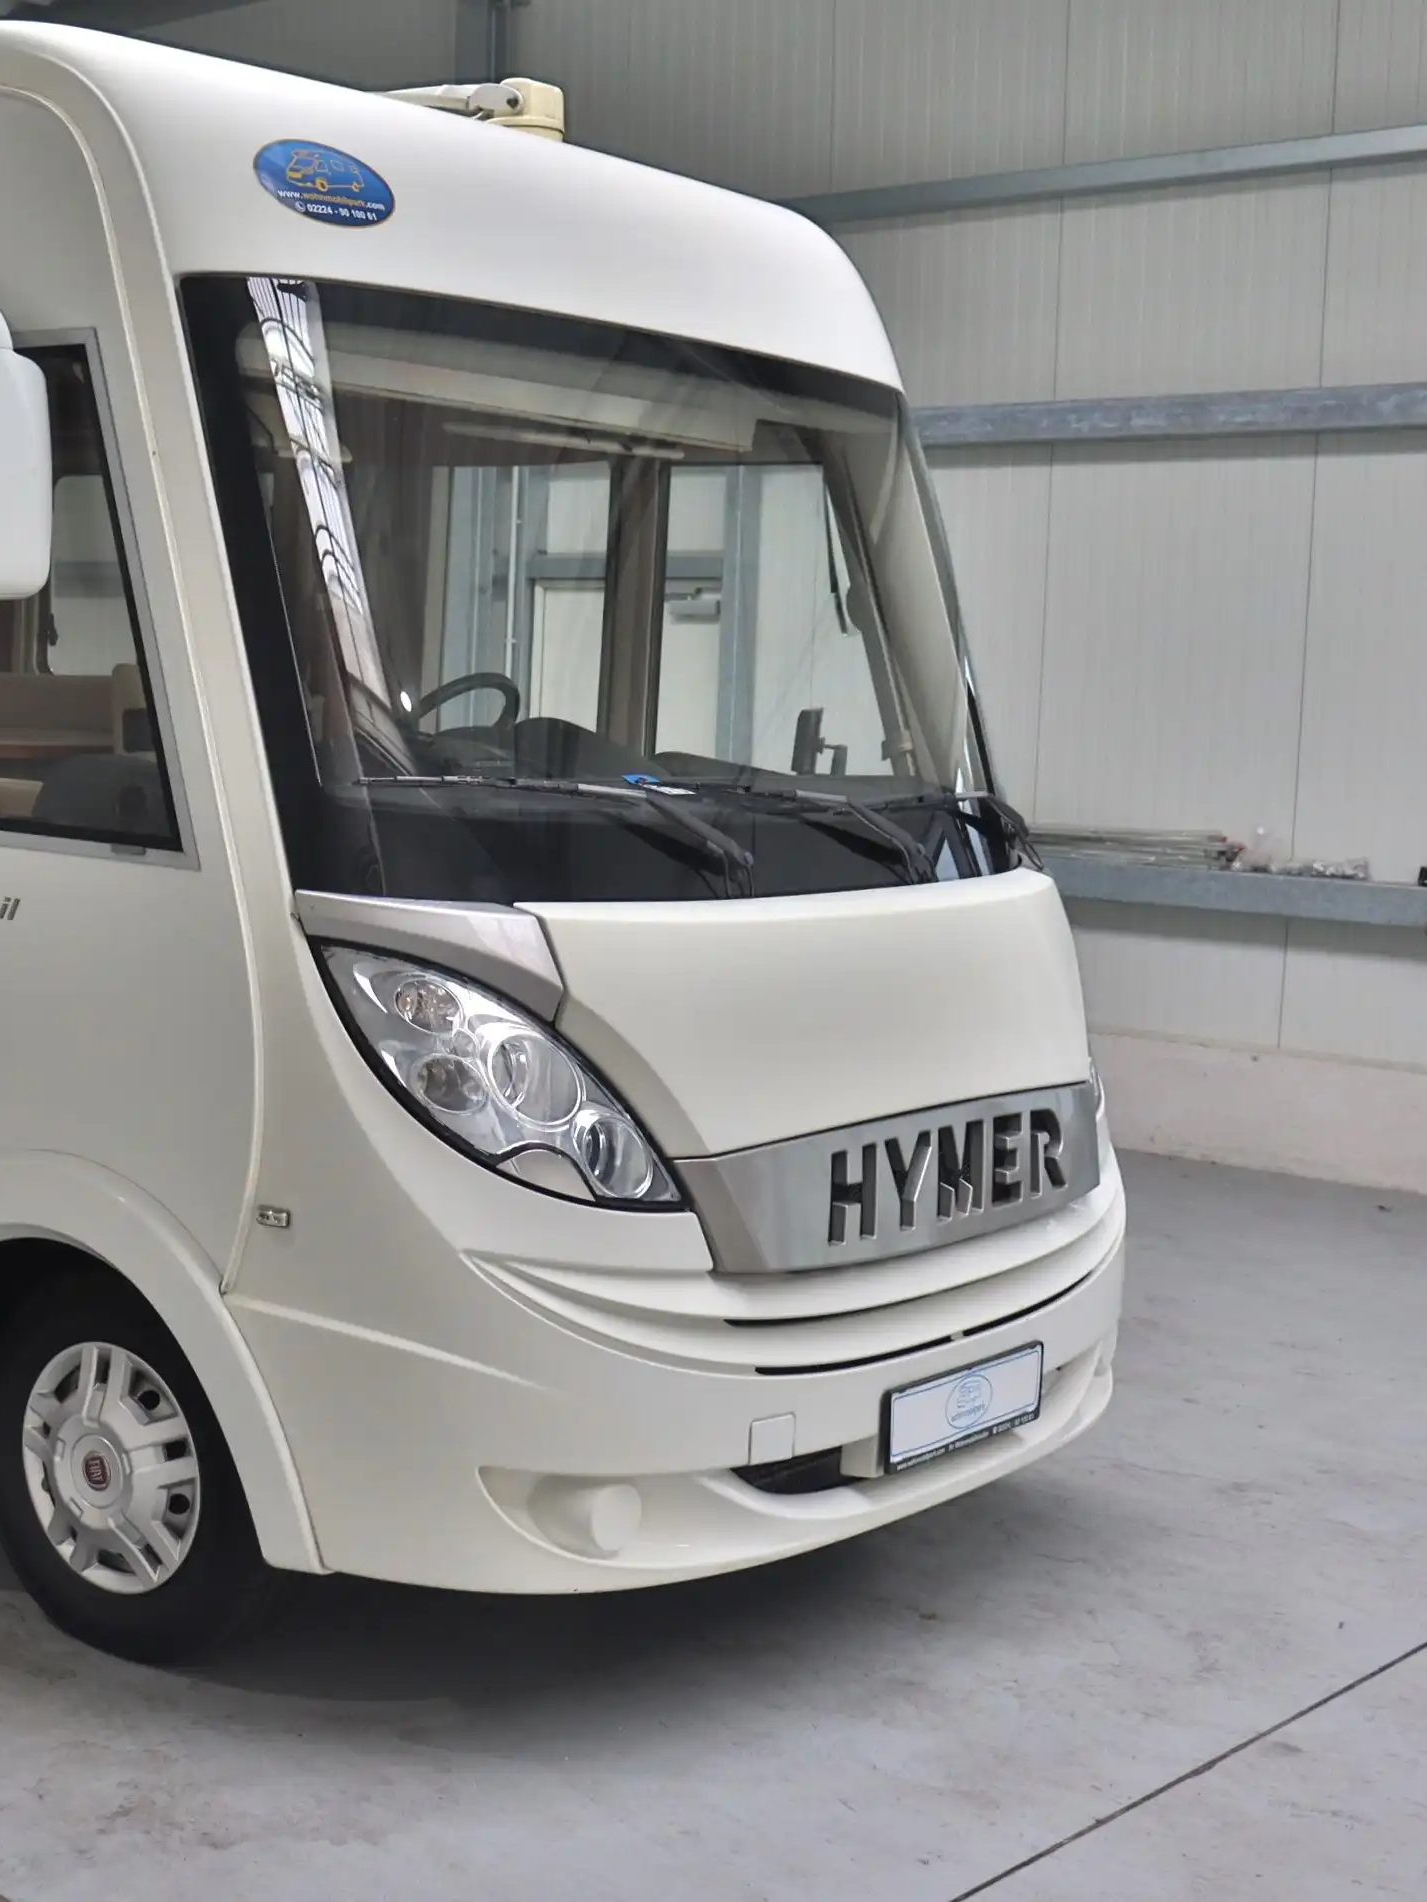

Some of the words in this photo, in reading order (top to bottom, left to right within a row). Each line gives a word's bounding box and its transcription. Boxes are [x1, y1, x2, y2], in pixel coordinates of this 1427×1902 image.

[306, 203, 333, 215] 02224
[351, 208, 366, 219] 100
[828, 1107, 1068, 1247] HYMER
[88, 1459, 103, 1482] FIAT
